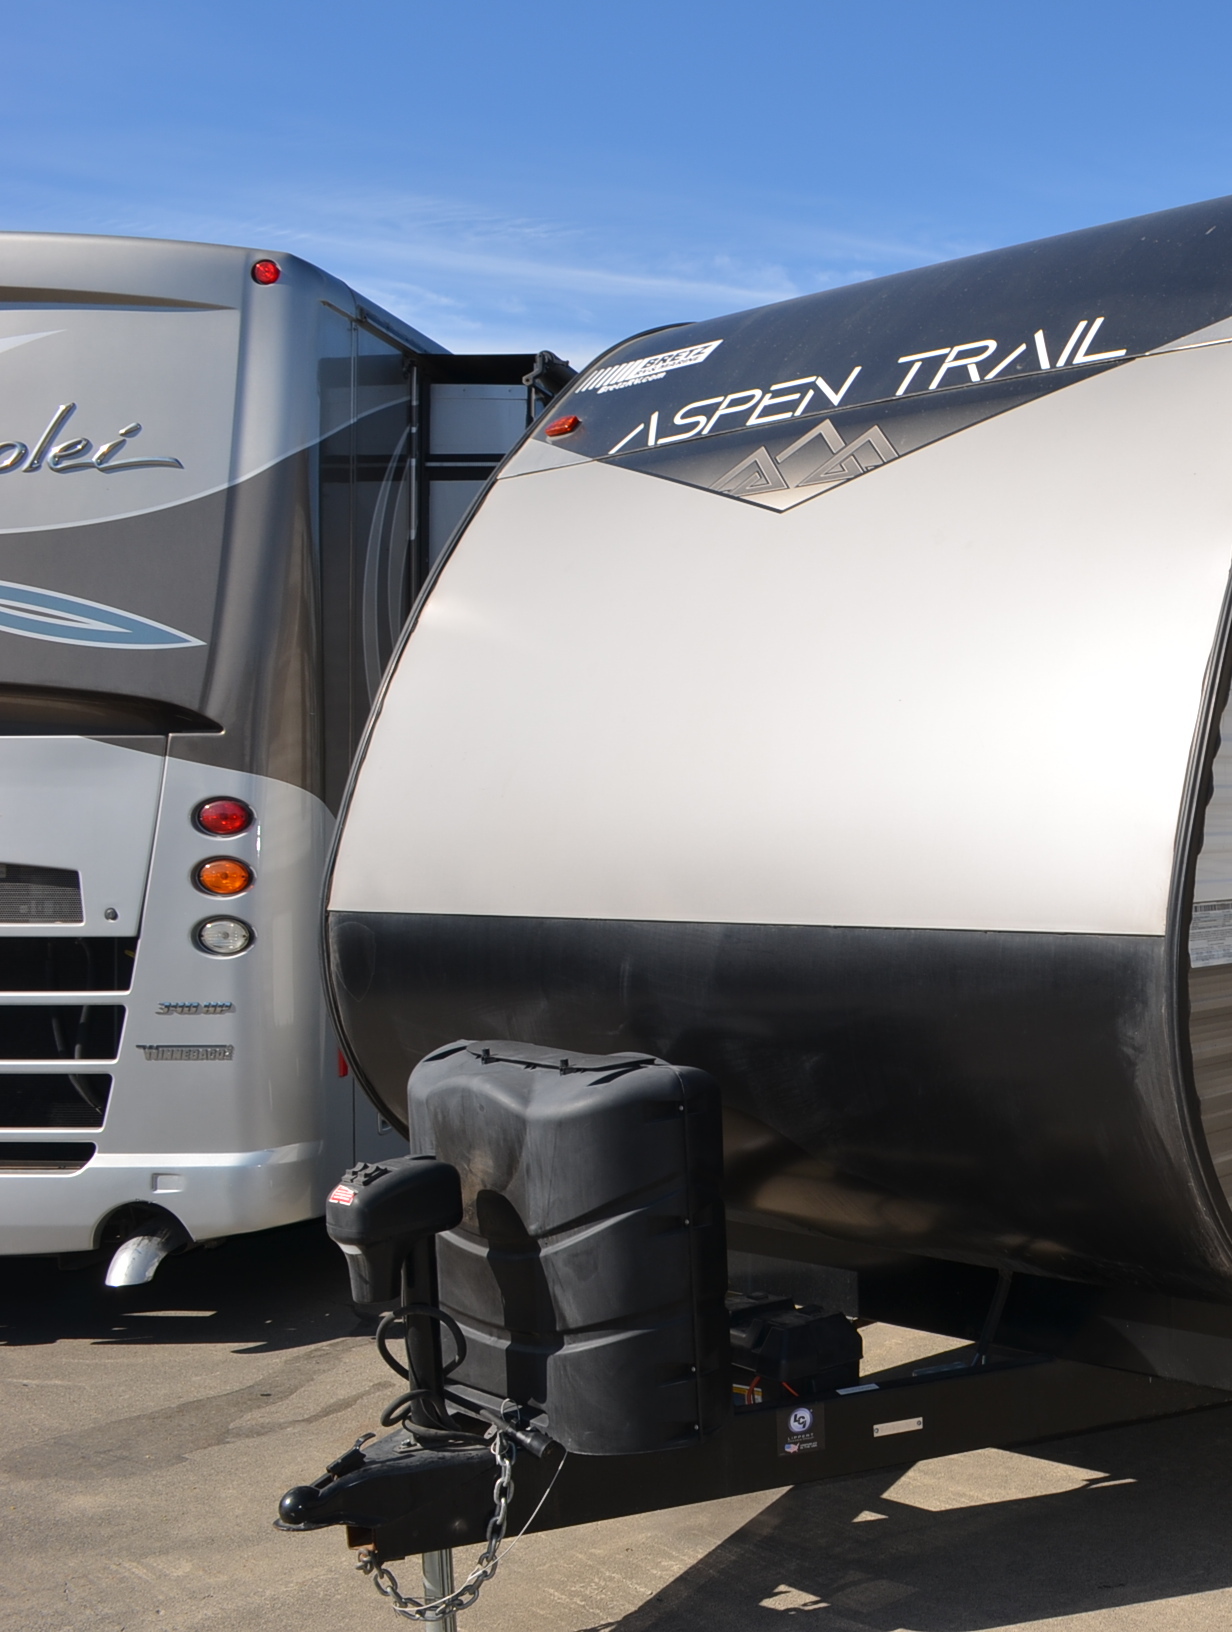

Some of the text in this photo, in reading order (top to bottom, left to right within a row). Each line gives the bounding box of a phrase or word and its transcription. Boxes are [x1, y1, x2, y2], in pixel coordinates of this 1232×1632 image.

[641, 344, 712, 368] BRETZ
[608, 316, 1127, 455] ASPEN TRAIL
[136, 1045, 230, 1061] WINNEBAGO
